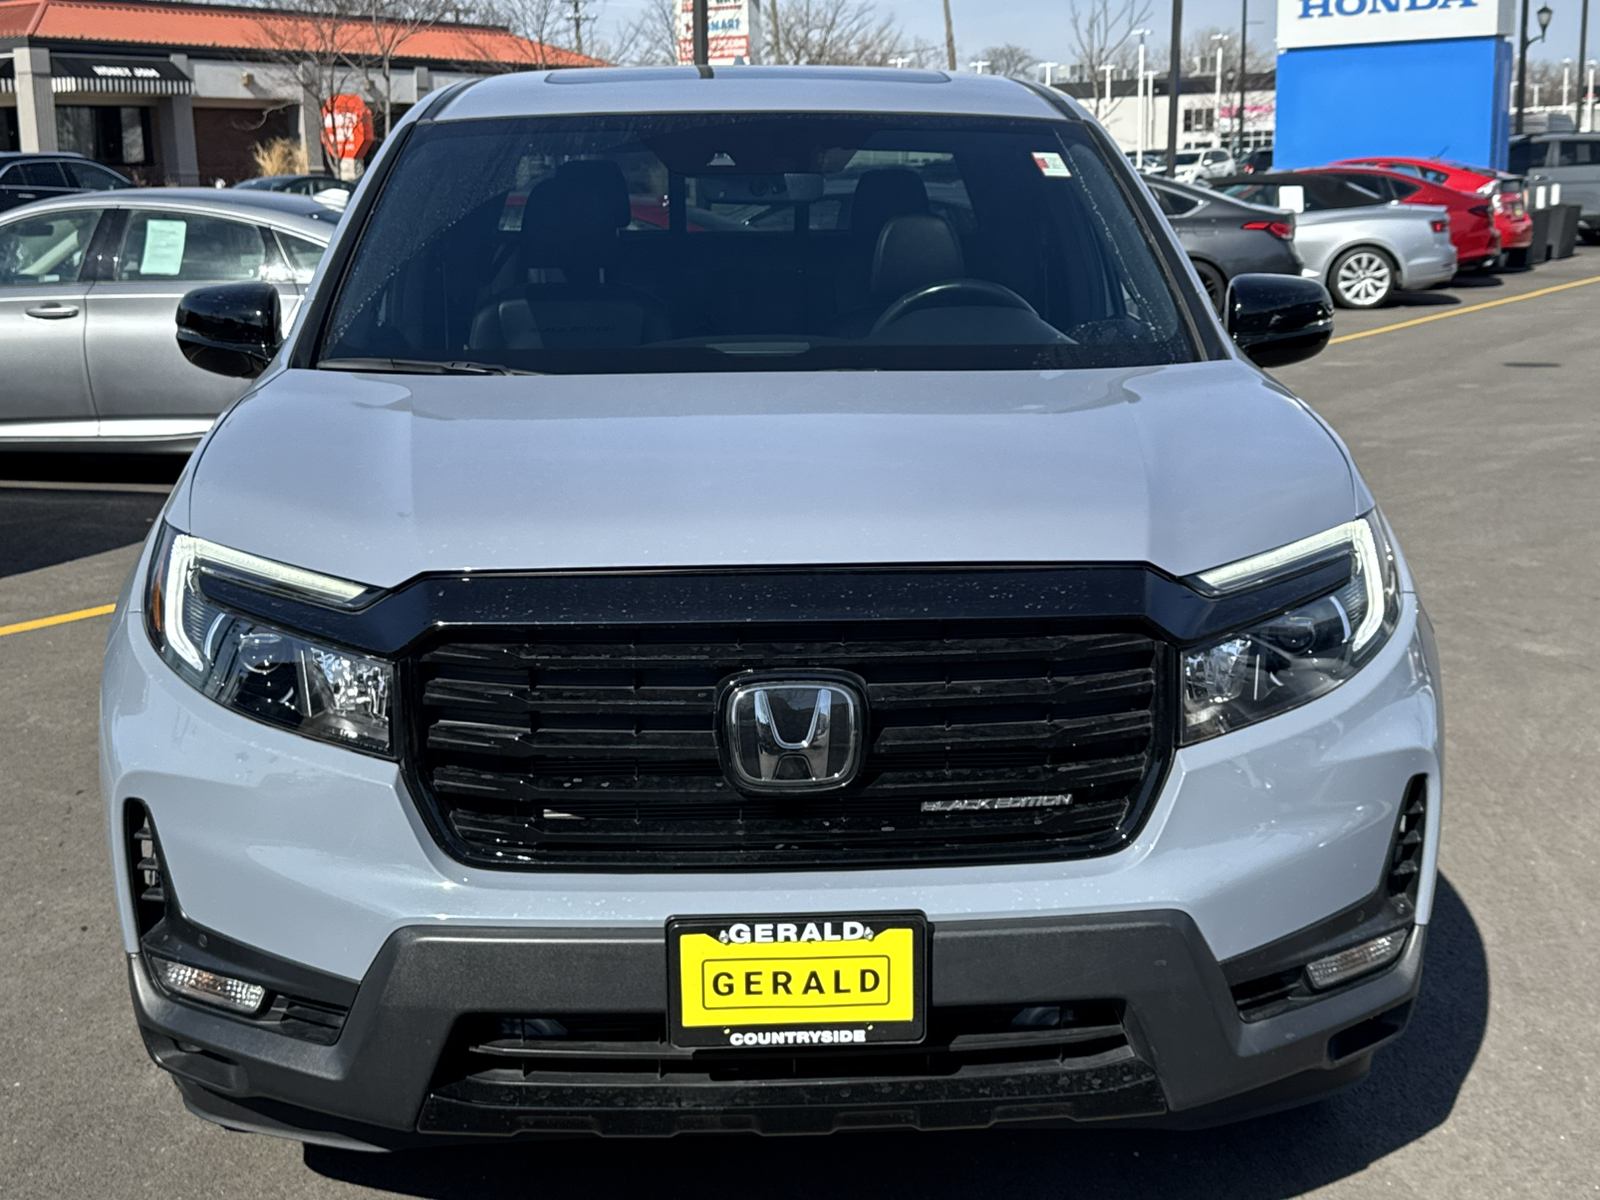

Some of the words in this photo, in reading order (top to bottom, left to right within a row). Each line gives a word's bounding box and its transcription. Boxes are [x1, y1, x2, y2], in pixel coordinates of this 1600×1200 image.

[920, 798, 992, 812] BLACK
[993, 793, 1074, 809] EDITION
[728, 920, 866, 944] GERALD
[712, 968, 881, 997] GERALD
[729, 1028, 867, 1047] COUNTRYSIDE
